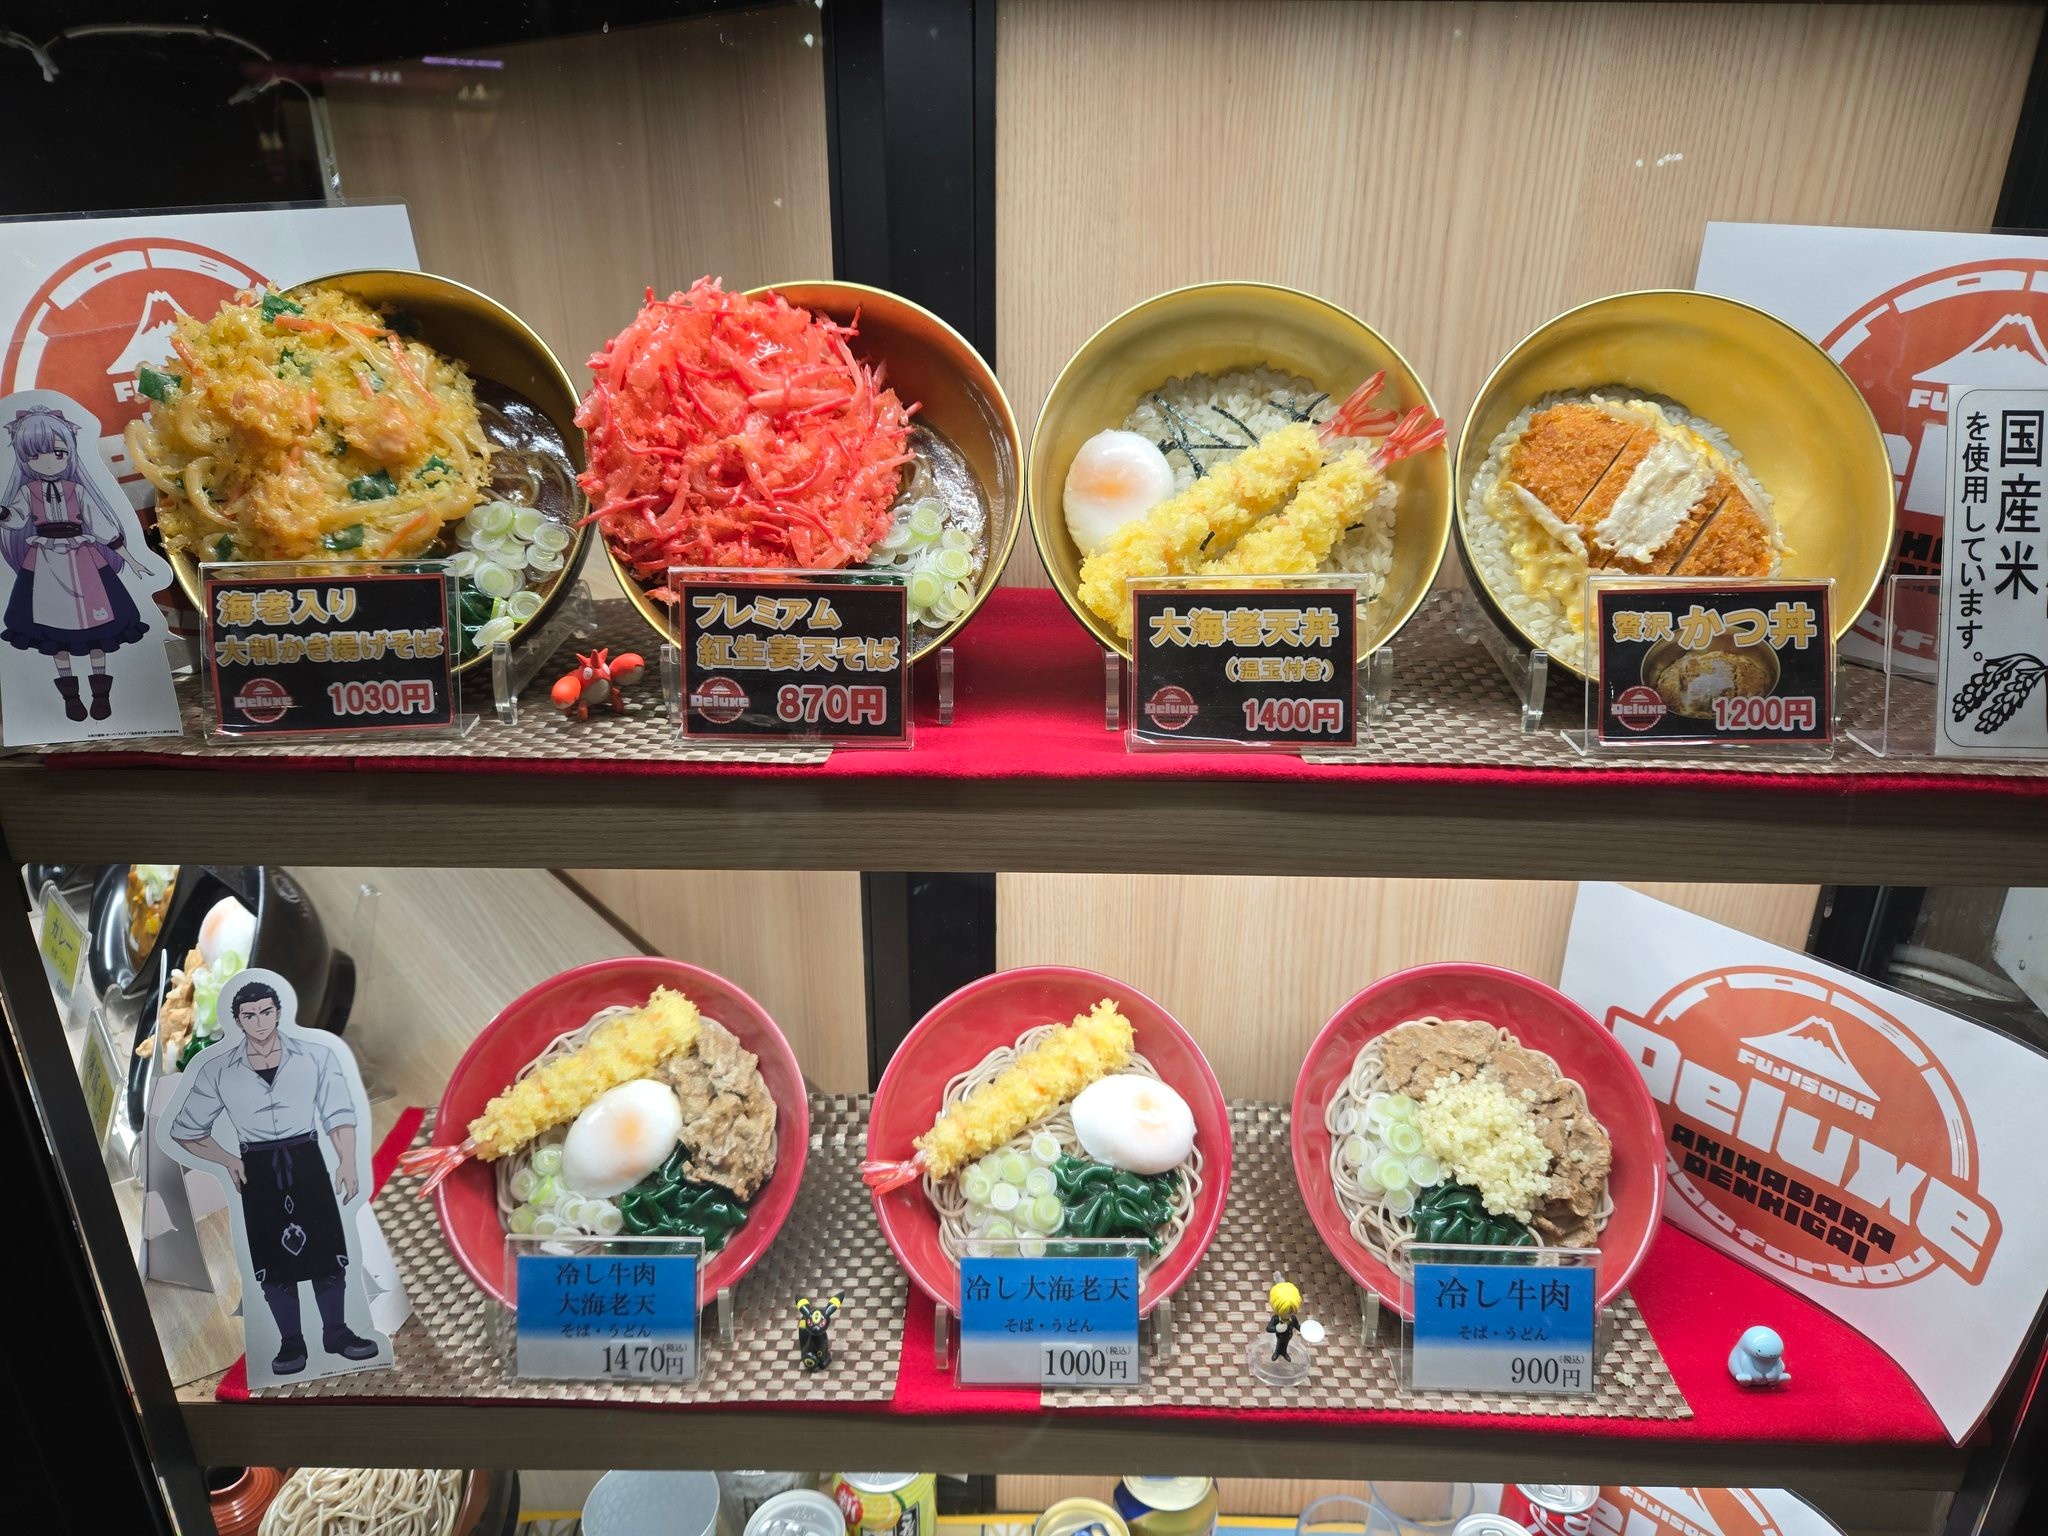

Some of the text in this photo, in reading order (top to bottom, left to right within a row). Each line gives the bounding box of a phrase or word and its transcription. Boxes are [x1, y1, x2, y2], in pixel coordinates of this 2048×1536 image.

[1994, 409, 2043, 600] 国産米
[1956, 410, 1991, 662] を使用しています。
[216, 588, 357, 628] 海老入り
[693, 592, 842, 630] プレミアム
[1150, 606, 1339, 648] 大海老天丼
[215, 628, 444, 667] 大判かき揚げそば
[696, 633, 900, 672] 紅生姜天そば
[328, 679, 435, 716] 1030円
[776, 684, 887, 725] 870円
[1243, 698, 1343, 733] 1400円
[1713, 696, 1816, 731] 1200円
[1737, 1048, 1876, 1121] FUJISOBA
[1671, 1123, 1896, 1254] AKIHABARA
[1683, 1152, 1870, 1265] DENKIGAI
[556, 1262, 656, 1286] 冷し牛肉
[966, 1274, 1130, 1302] 冷し大海老天
[558, 1292, 656, 1316] 大海老天
[1436, 1277, 1570, 1312] 冷し牛肉
[1619, 1486, 1708, 1536] FUJISO
